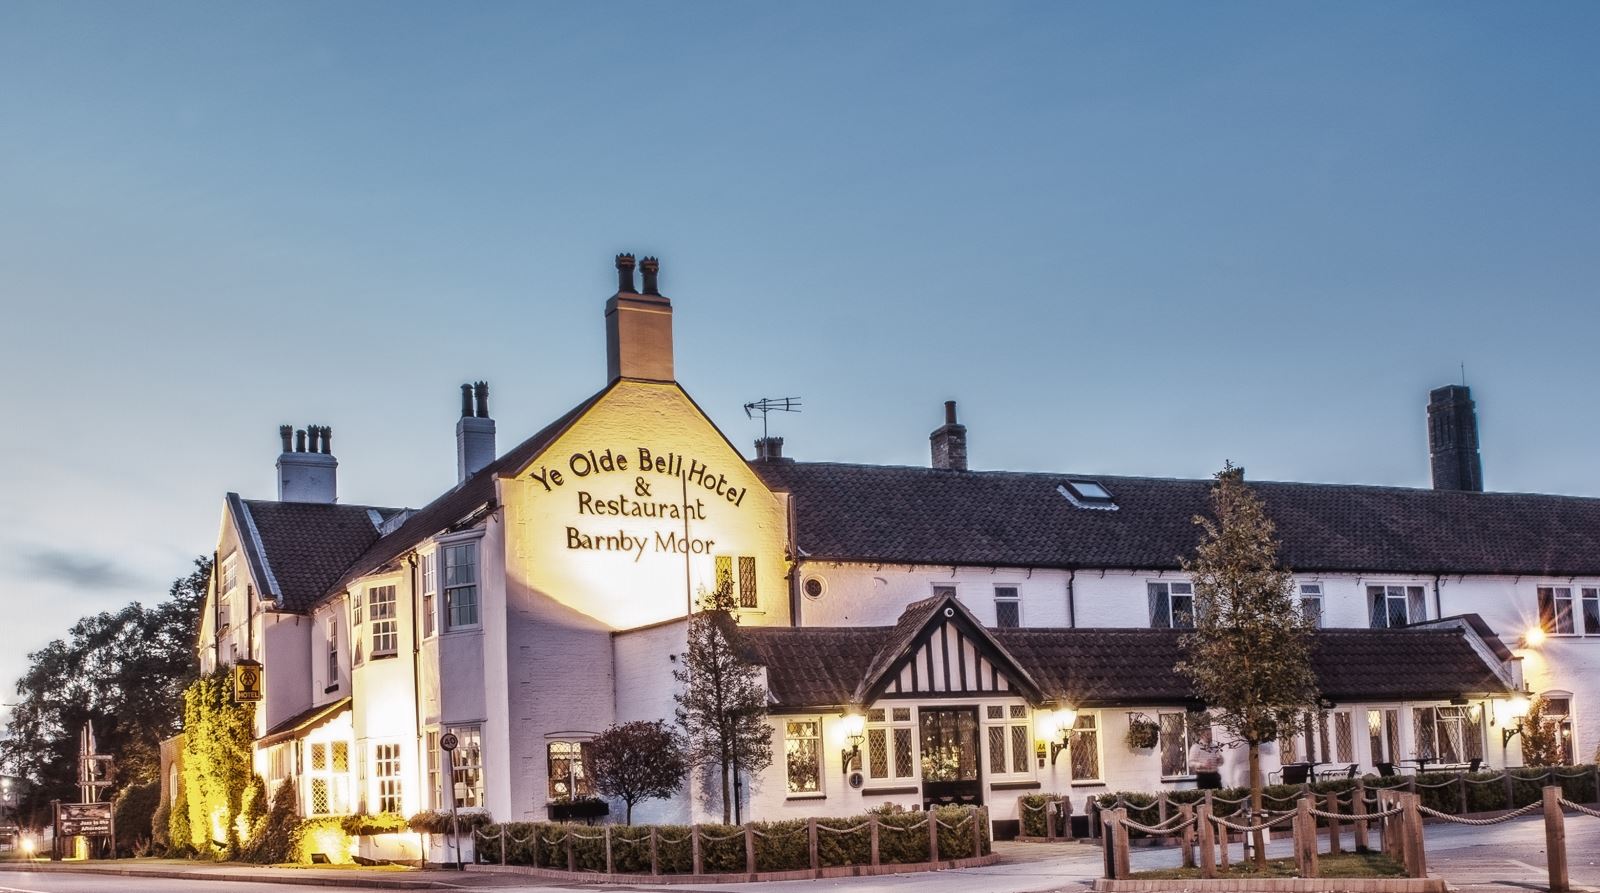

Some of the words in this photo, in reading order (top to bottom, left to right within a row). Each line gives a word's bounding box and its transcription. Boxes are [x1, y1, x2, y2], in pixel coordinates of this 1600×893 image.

[529, 466, 564, 492] Ye
[569, 448, 628, 477] Olde
[637, 447, 682, 477] Bell
[688, 459, 747, 507] Hotel
[634, 476, 652, 497] &
[578, 491, 706, 520] Restaurant
[566, 526, 648, 562] Barnby
[655, 531, 715, 554] Moor
